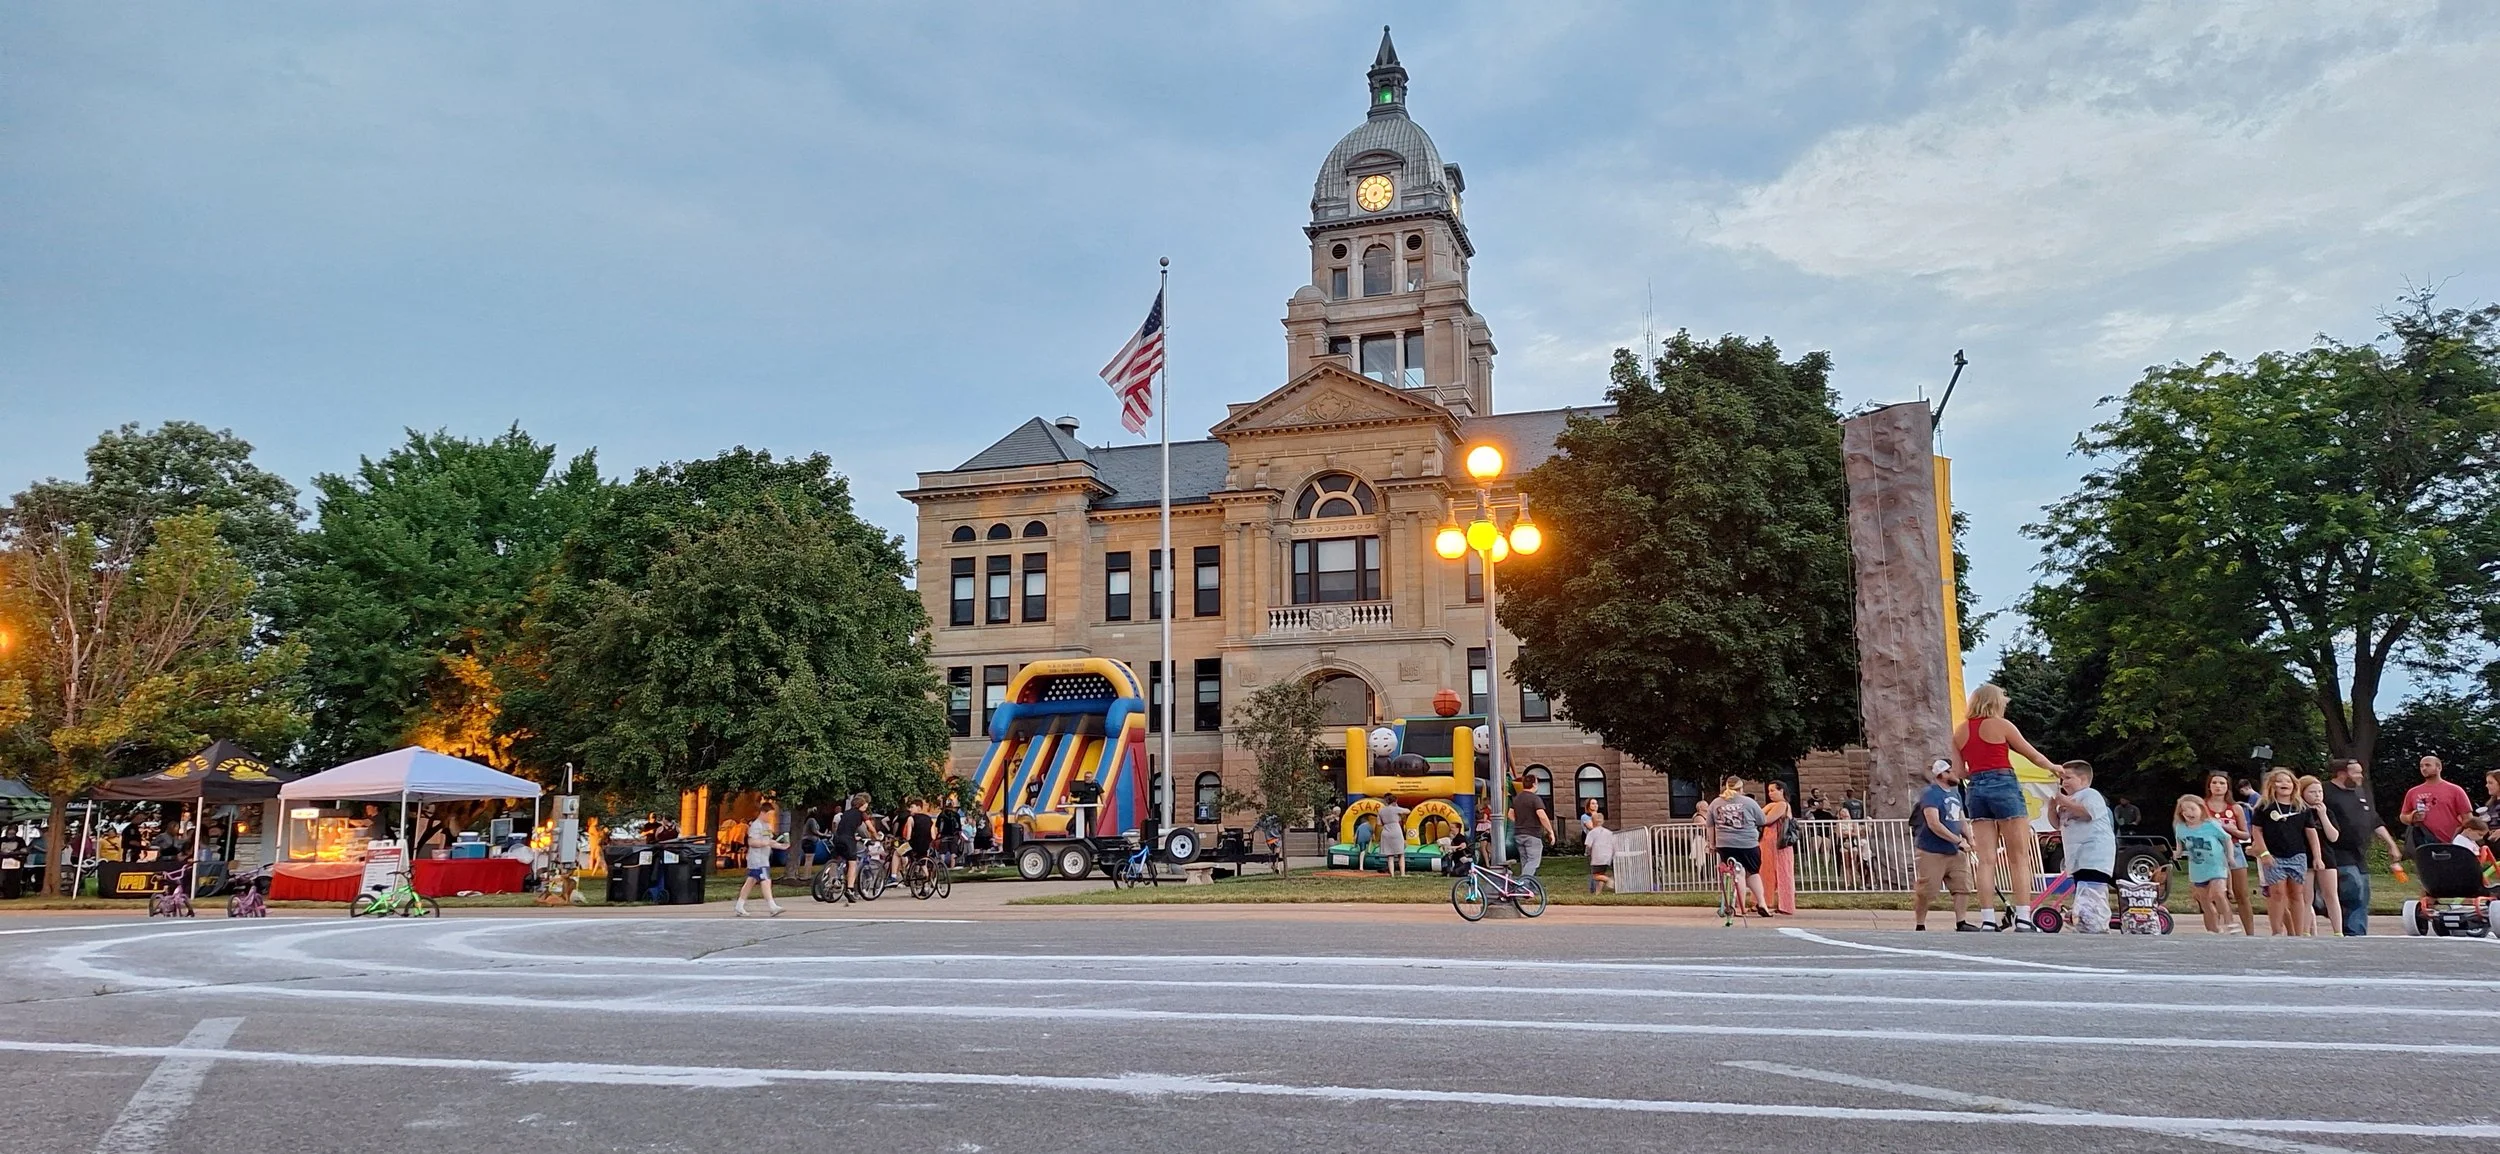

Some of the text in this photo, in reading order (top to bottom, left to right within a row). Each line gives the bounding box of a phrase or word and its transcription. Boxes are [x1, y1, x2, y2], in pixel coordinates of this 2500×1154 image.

[216, 757, 270, 772] VINTON
[1352, 801, 1381, 815] STAR
[1417, 803, 1455, 818] START
[2128, 897, 2153, 907] Roll
